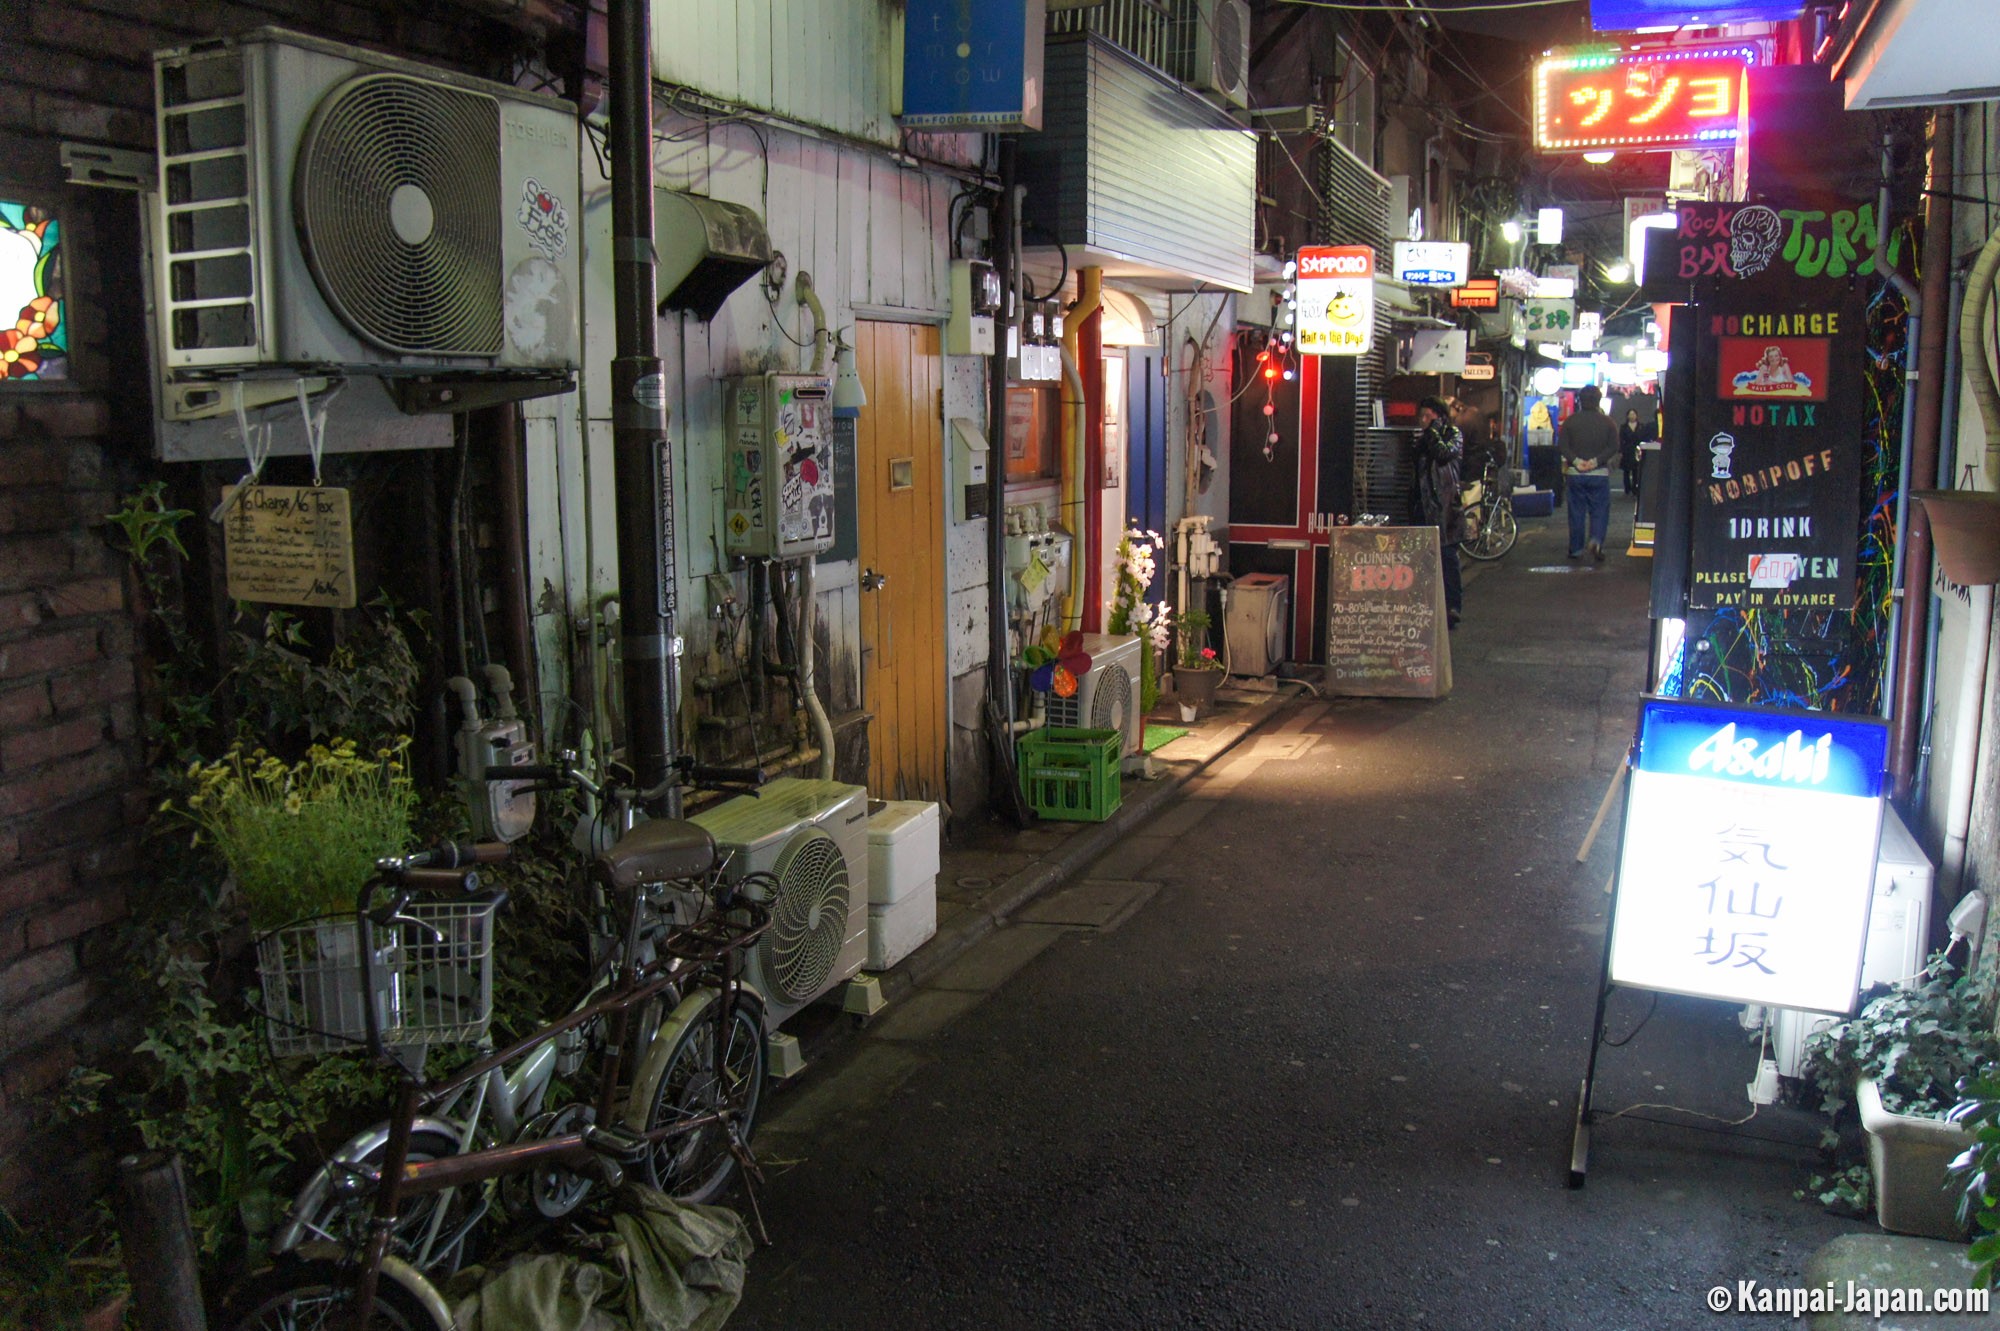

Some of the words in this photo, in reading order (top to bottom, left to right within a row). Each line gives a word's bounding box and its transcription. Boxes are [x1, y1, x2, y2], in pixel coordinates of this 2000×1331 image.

[506, 119, 568, 148] TOSHIBA
[1301, 329, 1316, 344] Hair
[311, 491, 335, 514] Tax
[1354, 551, 1411, 565] GUINNESS
[1798, 557, 1839, 579] YEN
[1351, 564, 1415, 592] HOD
[1696, 572, 1746, 584] PLEASE
[1716, 593, 1741, 605] PAY
[1750, 593, 1763, 605] IN
[1773, 593, 1836, 605] ADVANCE
[1688, 721, 1833, 785] Asahi
[1693, 822, 1788, 975] 気仙坂
